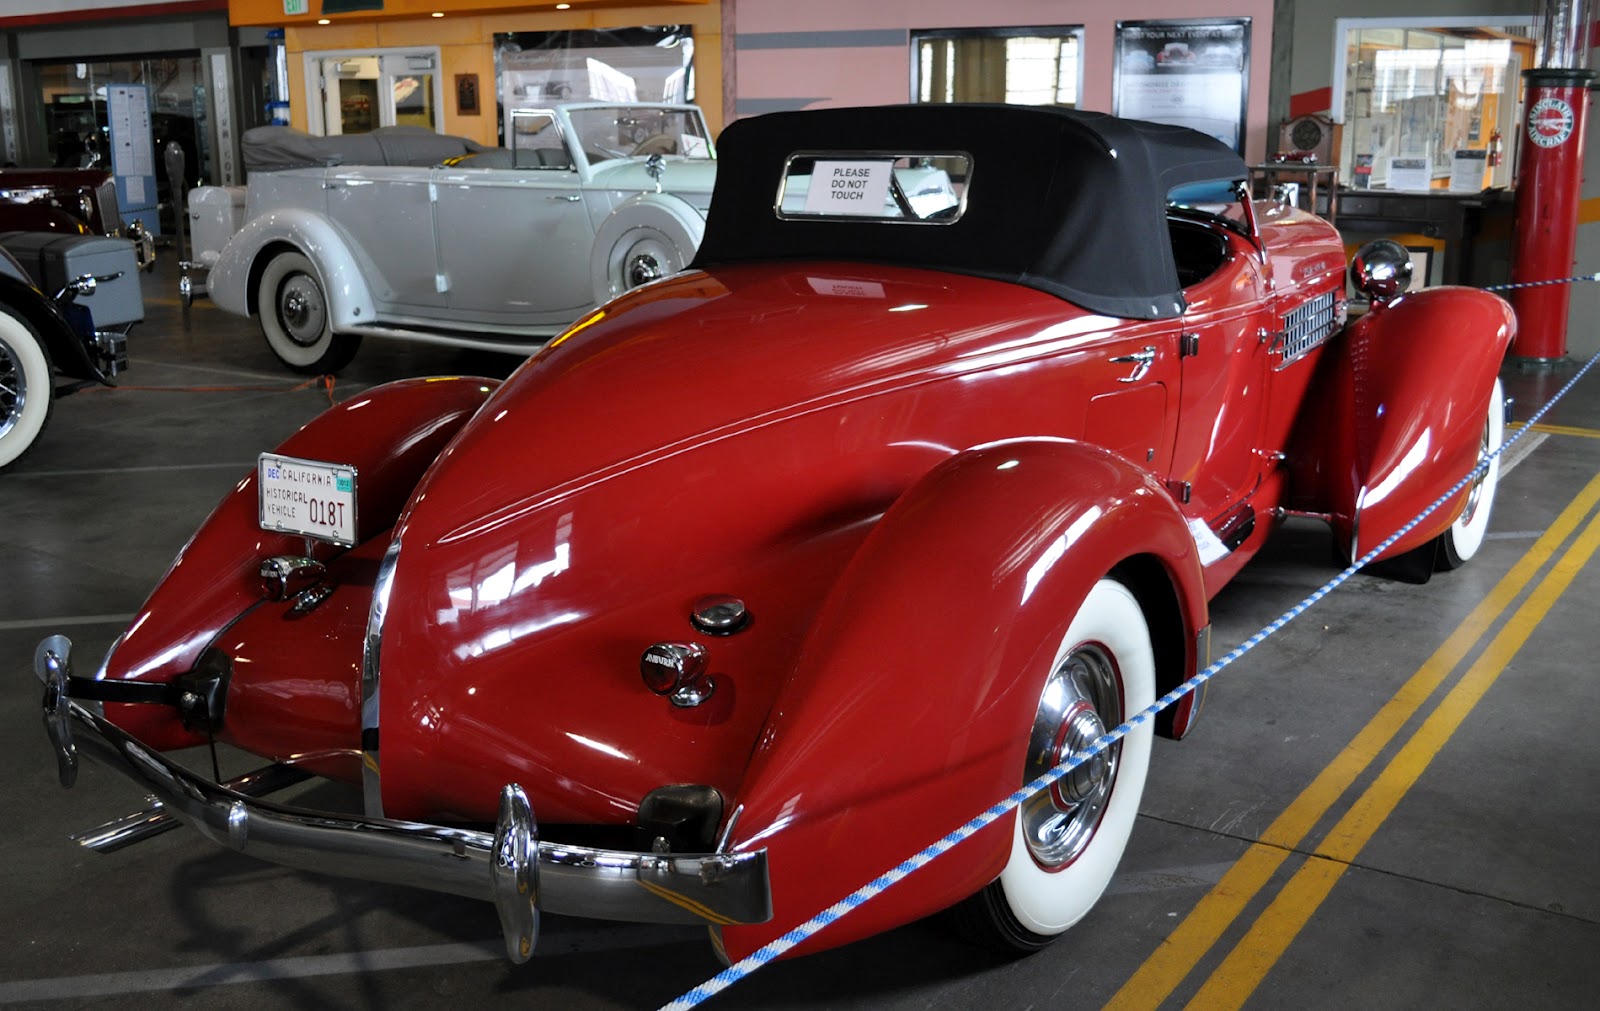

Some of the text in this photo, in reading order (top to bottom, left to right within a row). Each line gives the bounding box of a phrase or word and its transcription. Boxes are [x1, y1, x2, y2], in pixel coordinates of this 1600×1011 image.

[1146, 31, 1165, 39] YOUR
[1211, 30, 1221, 38] AT
[1529, 98, 1571, 118] SINCLAIR
[1529, 125, 1571, 147] AIRCRAFT
[833, 168, 870, 178] PLEASE
[831, 180, 868, 189] DO NOT
[831, 191, 863, 200] TOUCH
[267, 467, 332, 486] DEC CALIFORNIA
[266, 487, 308, 504] HISTORICAL
[267, 503, 296, 518] VEHICLE
[310, 498, 345, 529] 018T
[645, 653, 675, 668] AUBURN
